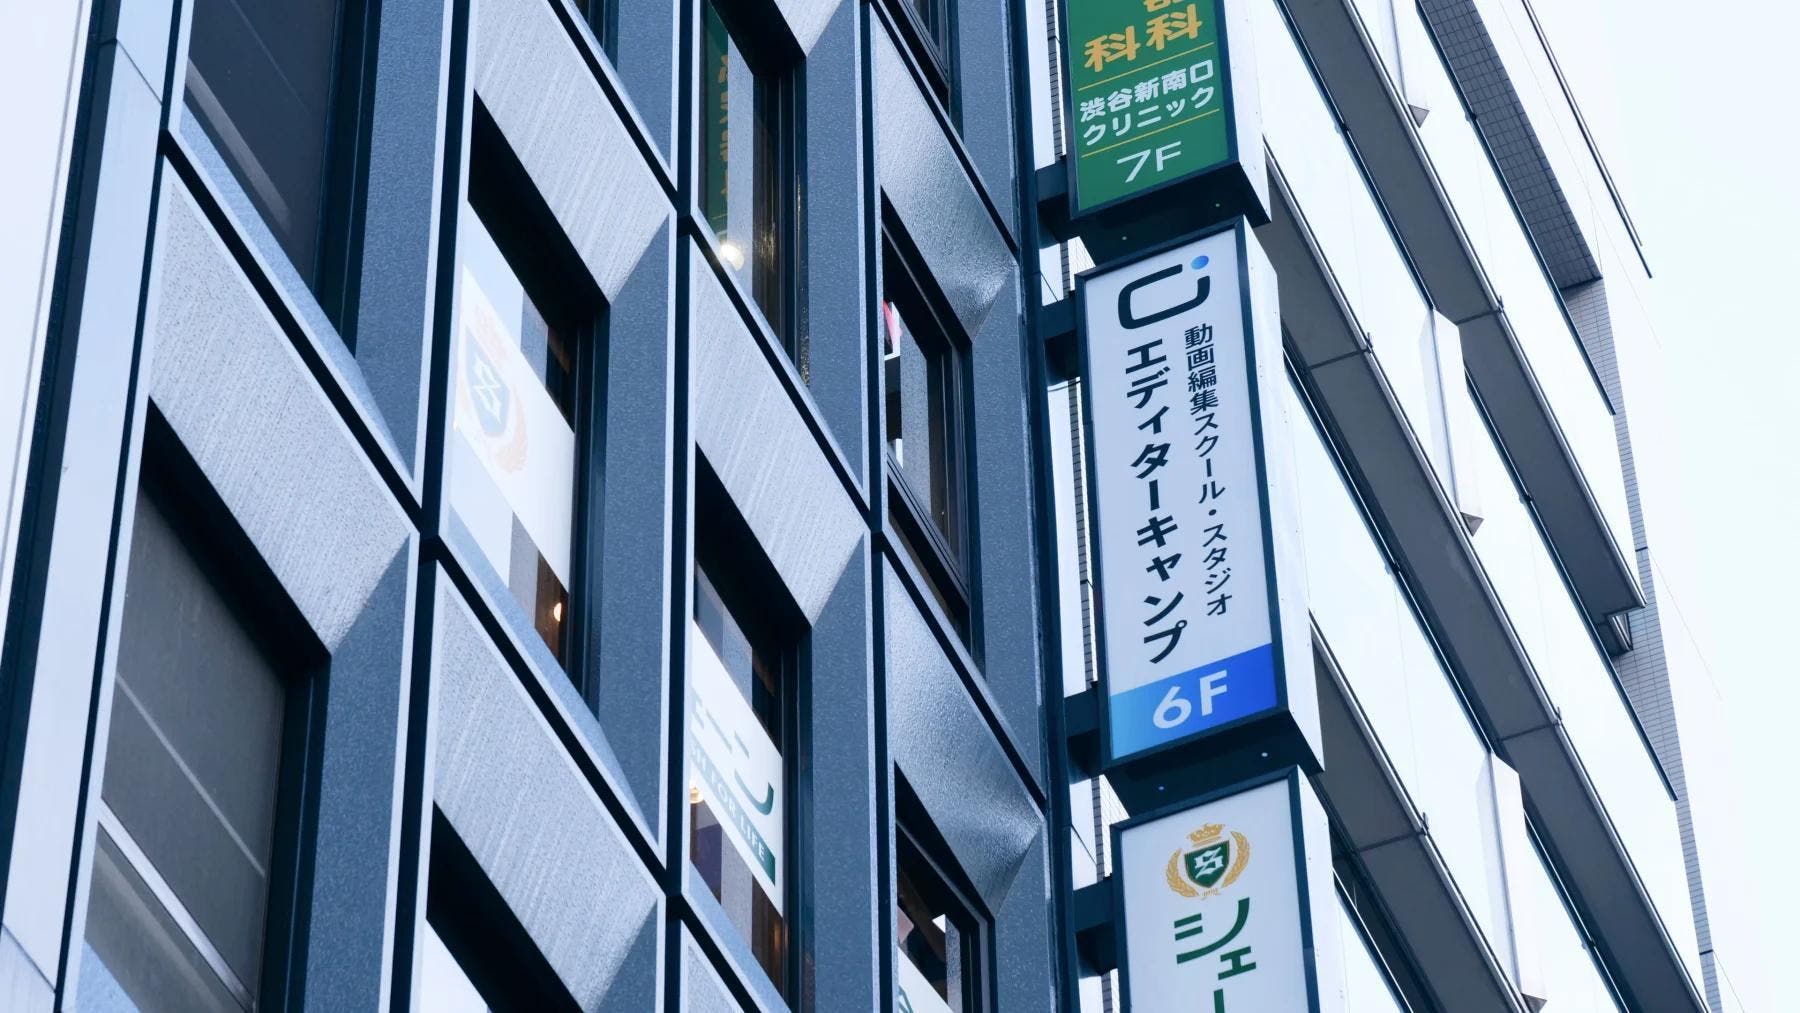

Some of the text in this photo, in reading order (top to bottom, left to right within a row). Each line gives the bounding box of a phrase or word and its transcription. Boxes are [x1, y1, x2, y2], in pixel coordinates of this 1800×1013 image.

[1079, 59, 1215, 123] 渋谷新南口
[1083, 86, 1215, 146] クリニック
[1116, 141, 1182, 184] 7F
[1184, 323, 1233, 616] 動画編集スクール・スタジオ
[1125, 338, 1188, 664] エディターキャンプ
[1152, 669, 1228, 729] 6F
[740, 816, 766, 863] LIFE
